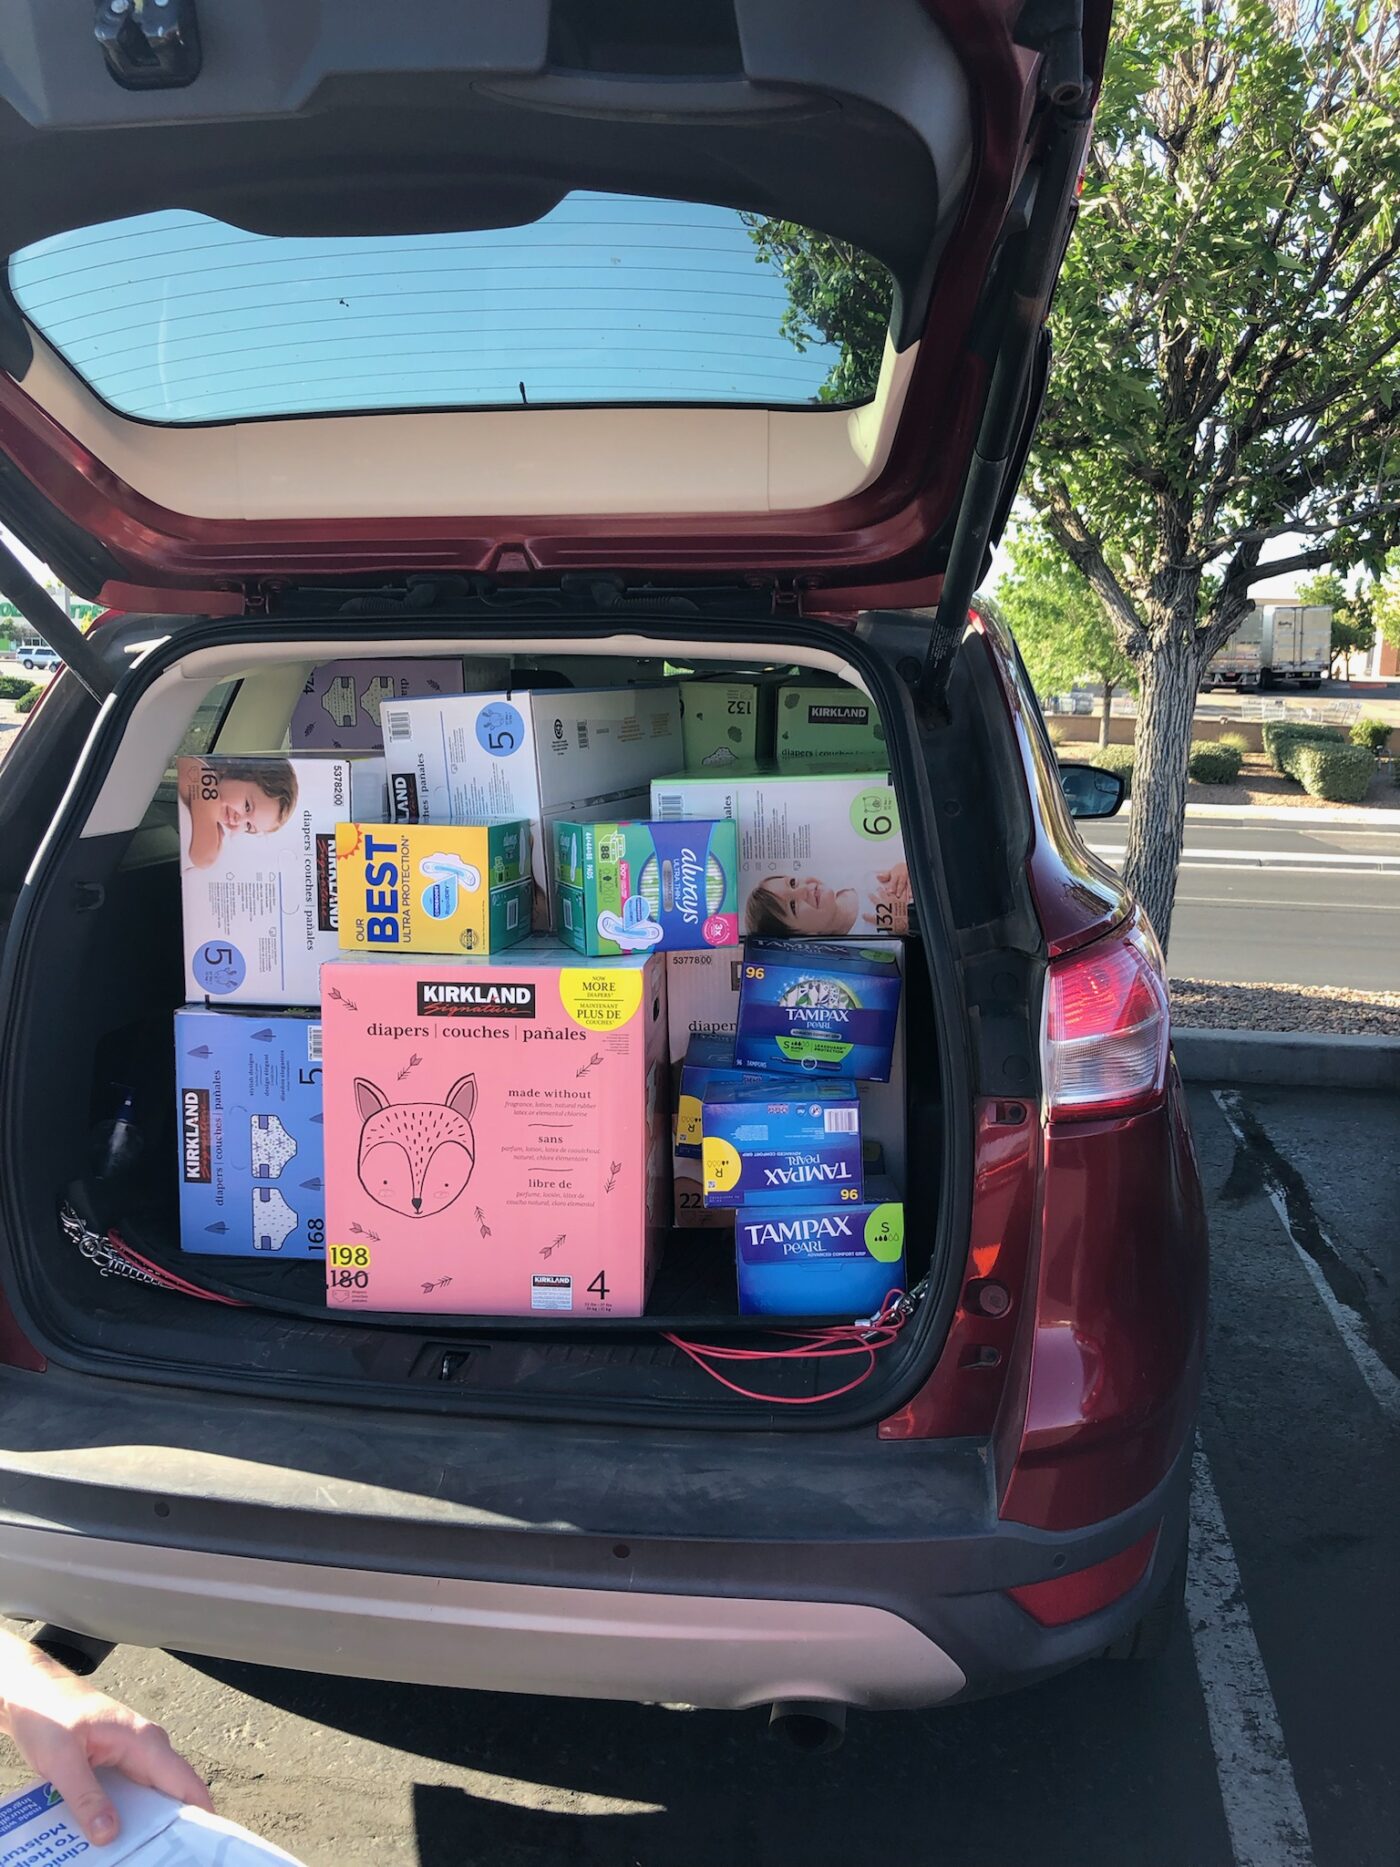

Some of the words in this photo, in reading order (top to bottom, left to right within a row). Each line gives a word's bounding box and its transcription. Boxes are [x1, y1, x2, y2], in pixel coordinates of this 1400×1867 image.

[727, 700, 752, 715] 132
[811, 707, 867, 718] KIRKLAND
[488, 731, 515, 750] 5
[200, 766, 219, 801] 168
[332, 765, 344, 806] 5378200
[394, 776, 410, 823] LAND
[301, 809, 314, 851] diapers
[862, 815, 892, 836] 6
[601, 845, 609, 859] 88
[586, 864, 594, 880] PADS
[673, 858, 681, 882] ULTRA
[303, 859, 315, 902] couches
[364, 834, 399, 943] BEST
[674, 847, 704, 925] always
[402, 908, 411, 943] ULTRA
[876, 903, 893, 933] 132
[304, 910, 316, 951] pañales
[356, 918, 365, 942] OUR
[204, 946, 233, 965] 5
[672, 955, 712, 965] 5377800
[745, 966, 765, 980] 96
[422, 984, 531, 1005] KIRKLAND
[582, 982, 616, 992] MORE
[422, 1001, 532, 1017] Signature
[577, 1009, 603, 1019] PLUS
[606, 1010, 622, 1020] DE
[785, 1008, 850, 1023] TAMPAX
[366, 1022, 430, 1041] diapers
[441, 1023, 509, 1040] couches
[522, 1025, 587, 1042] pañales
[688, 1020, 737, 1033] diaper
[783, 1040, 790, 1049] S
[299, 1067, 323, 1085] 5
[212, 1070, 224, 1110] pañales
[508, 1088, 541, 1098] made
[544, 1089, 592, 1099] without
[185, 1091, 201, 1178] KIRKLAND
[687, 1123, 696, 1133] R
[213, 1117, 223, 1160] couches
[538, 1135, 564, 1143] sans
[715, 1168, 724, 1178] R
[763, 1161, 852, 1186] TAMPAX
[213, 1167, 225, 1207] diapers
[528, 1178, 556, 1188] libre
[558, 1179, 573, 1189] de
[840, 1188, 859, 1200] 96
[307, 1218, 324, 1252] 168
[744, 1215, 853, 1246] TAMPAX
[881, 1222, 890, 1233] S
[330, 1247, 368, 1266] 198
[330, 1269, 369, 1289] 180
[534, 1276, 570, 1284] KIRKLAND
[586, 1269, 611, 1300] 4
[55, 1833, 80, 1847] To
